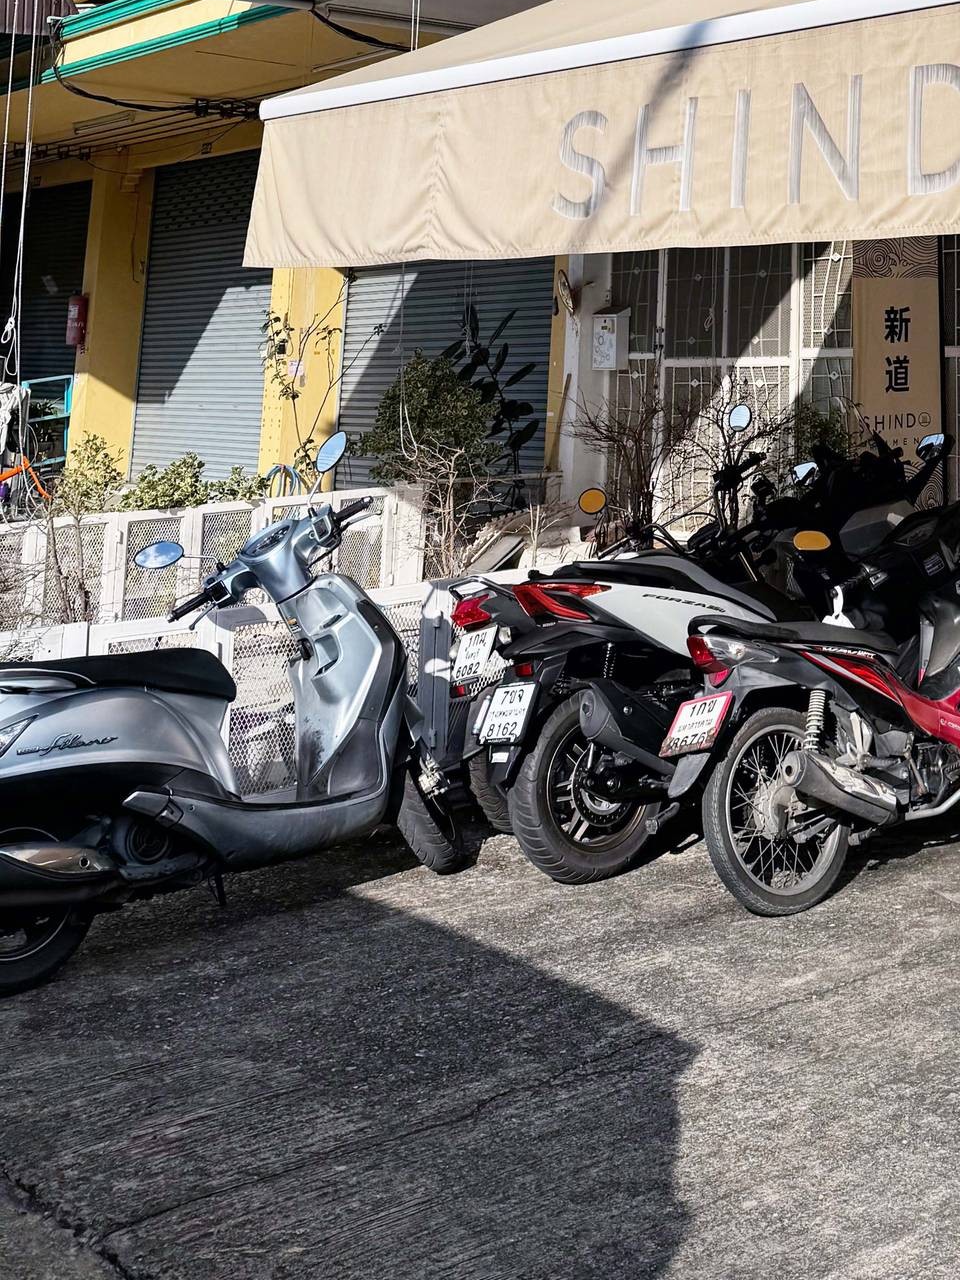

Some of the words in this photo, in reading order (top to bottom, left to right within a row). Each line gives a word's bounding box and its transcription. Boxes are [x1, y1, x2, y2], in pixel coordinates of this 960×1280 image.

[884, 306, 911, 393] 新道
[642, 593, 706, 608] FORZA
[455, 661, 480, 678] 6082
[486, 721, 518, 737] 8162
